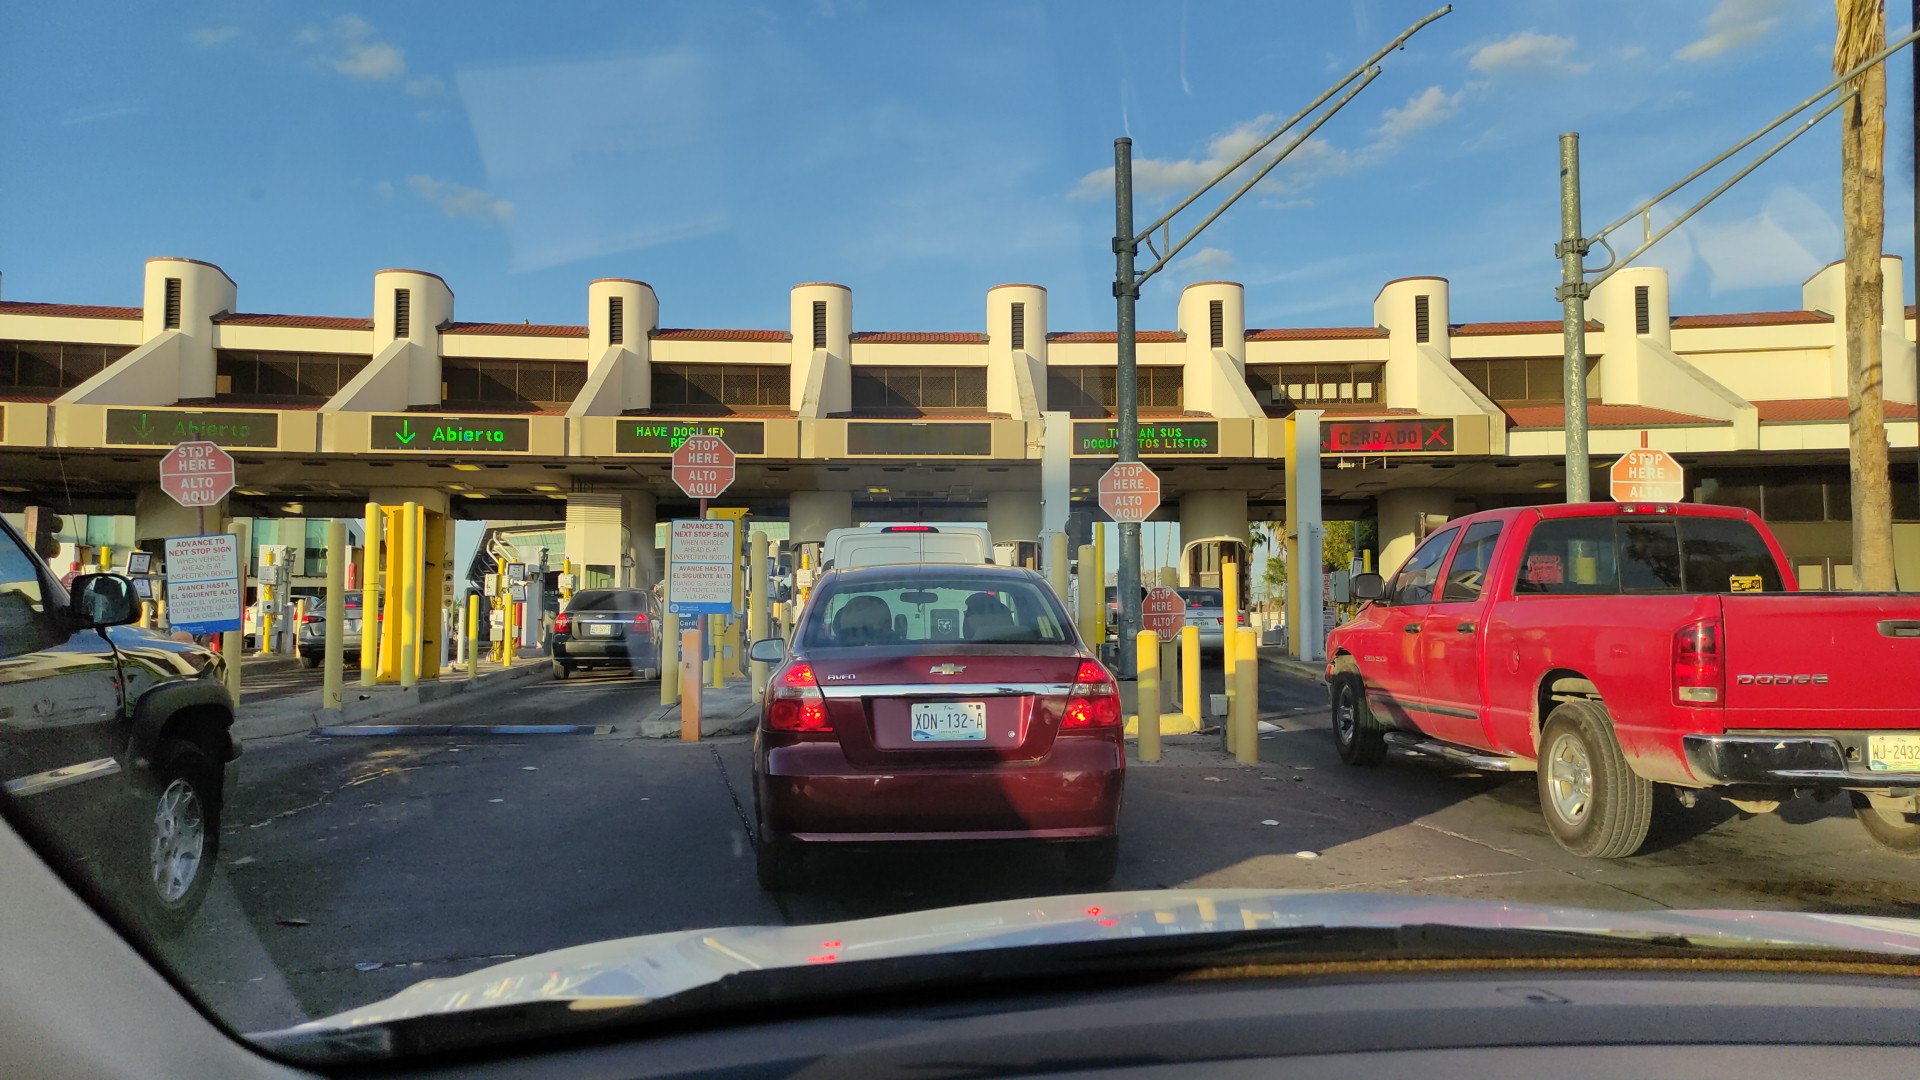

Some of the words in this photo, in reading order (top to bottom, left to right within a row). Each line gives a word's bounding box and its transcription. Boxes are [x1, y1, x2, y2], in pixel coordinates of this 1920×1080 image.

[173, 420, 251, 438] Abierto
[432, 426, 504, 442] Abierto
[636, 426, 668, 437] HAVE
[1107, 427, 1155, 438] TAN
[1160, 427, 1182, 438] SUS
[1083, 438, 1160, 449] DOCUMTOS
[1164, 438, 1208, 449] LISTOS
[1338, 430, 1418, 446] CERRADO
[688, 440, 719, 450] STOP
[178, 446, 214, 458] STOP
[688, 453, 720, 464] HERE
[1628, 453, 1663, 465] STOP
[178, 459, 216, 471] HERE
[688, 470, 717, 481] ALTO
[1113, 466, 1143, 477] STOP
[1628, 467, 1665, 479] HERE
[181, 477, 214, 489] ALTO
[1113, 479, 1145, 489] HERE
[688, 483, 717, 495] AQUI
[1630, 486, 1661, 498] ALTO
[181, 490, 215, 503] AQUI
[1114, 495, 1142, 506] ALTO
[1114, 508, 1143, 519] AQUI
[176, 539, 213, 548] ADVANCE
[168, 549, 189, 557] NEXT
[191, 547, 211, 556] STOP
[177, 557, 197, 565] WHEN
[199, 555, 226, 563] VEHICLE
[170, 571, 209, 580] INSPECTION
[211, 569, 234, 577] BOOTH
[177, 583, 205, 591] AVANCE
[206, 582, 230, 590] HASTA
[181, 590, 218, 599] SIGUIENTE
[220, 588, 237, 596] ALTO
[1151, 590, 1171, 600] STOP
[1151, 602, 1172, 611] HERE
[1152, 617, 1170, 627] ALTO
[1736, 673, 1829, 685] DODGE
[915, 712, 983, 730] XDN-132-A
